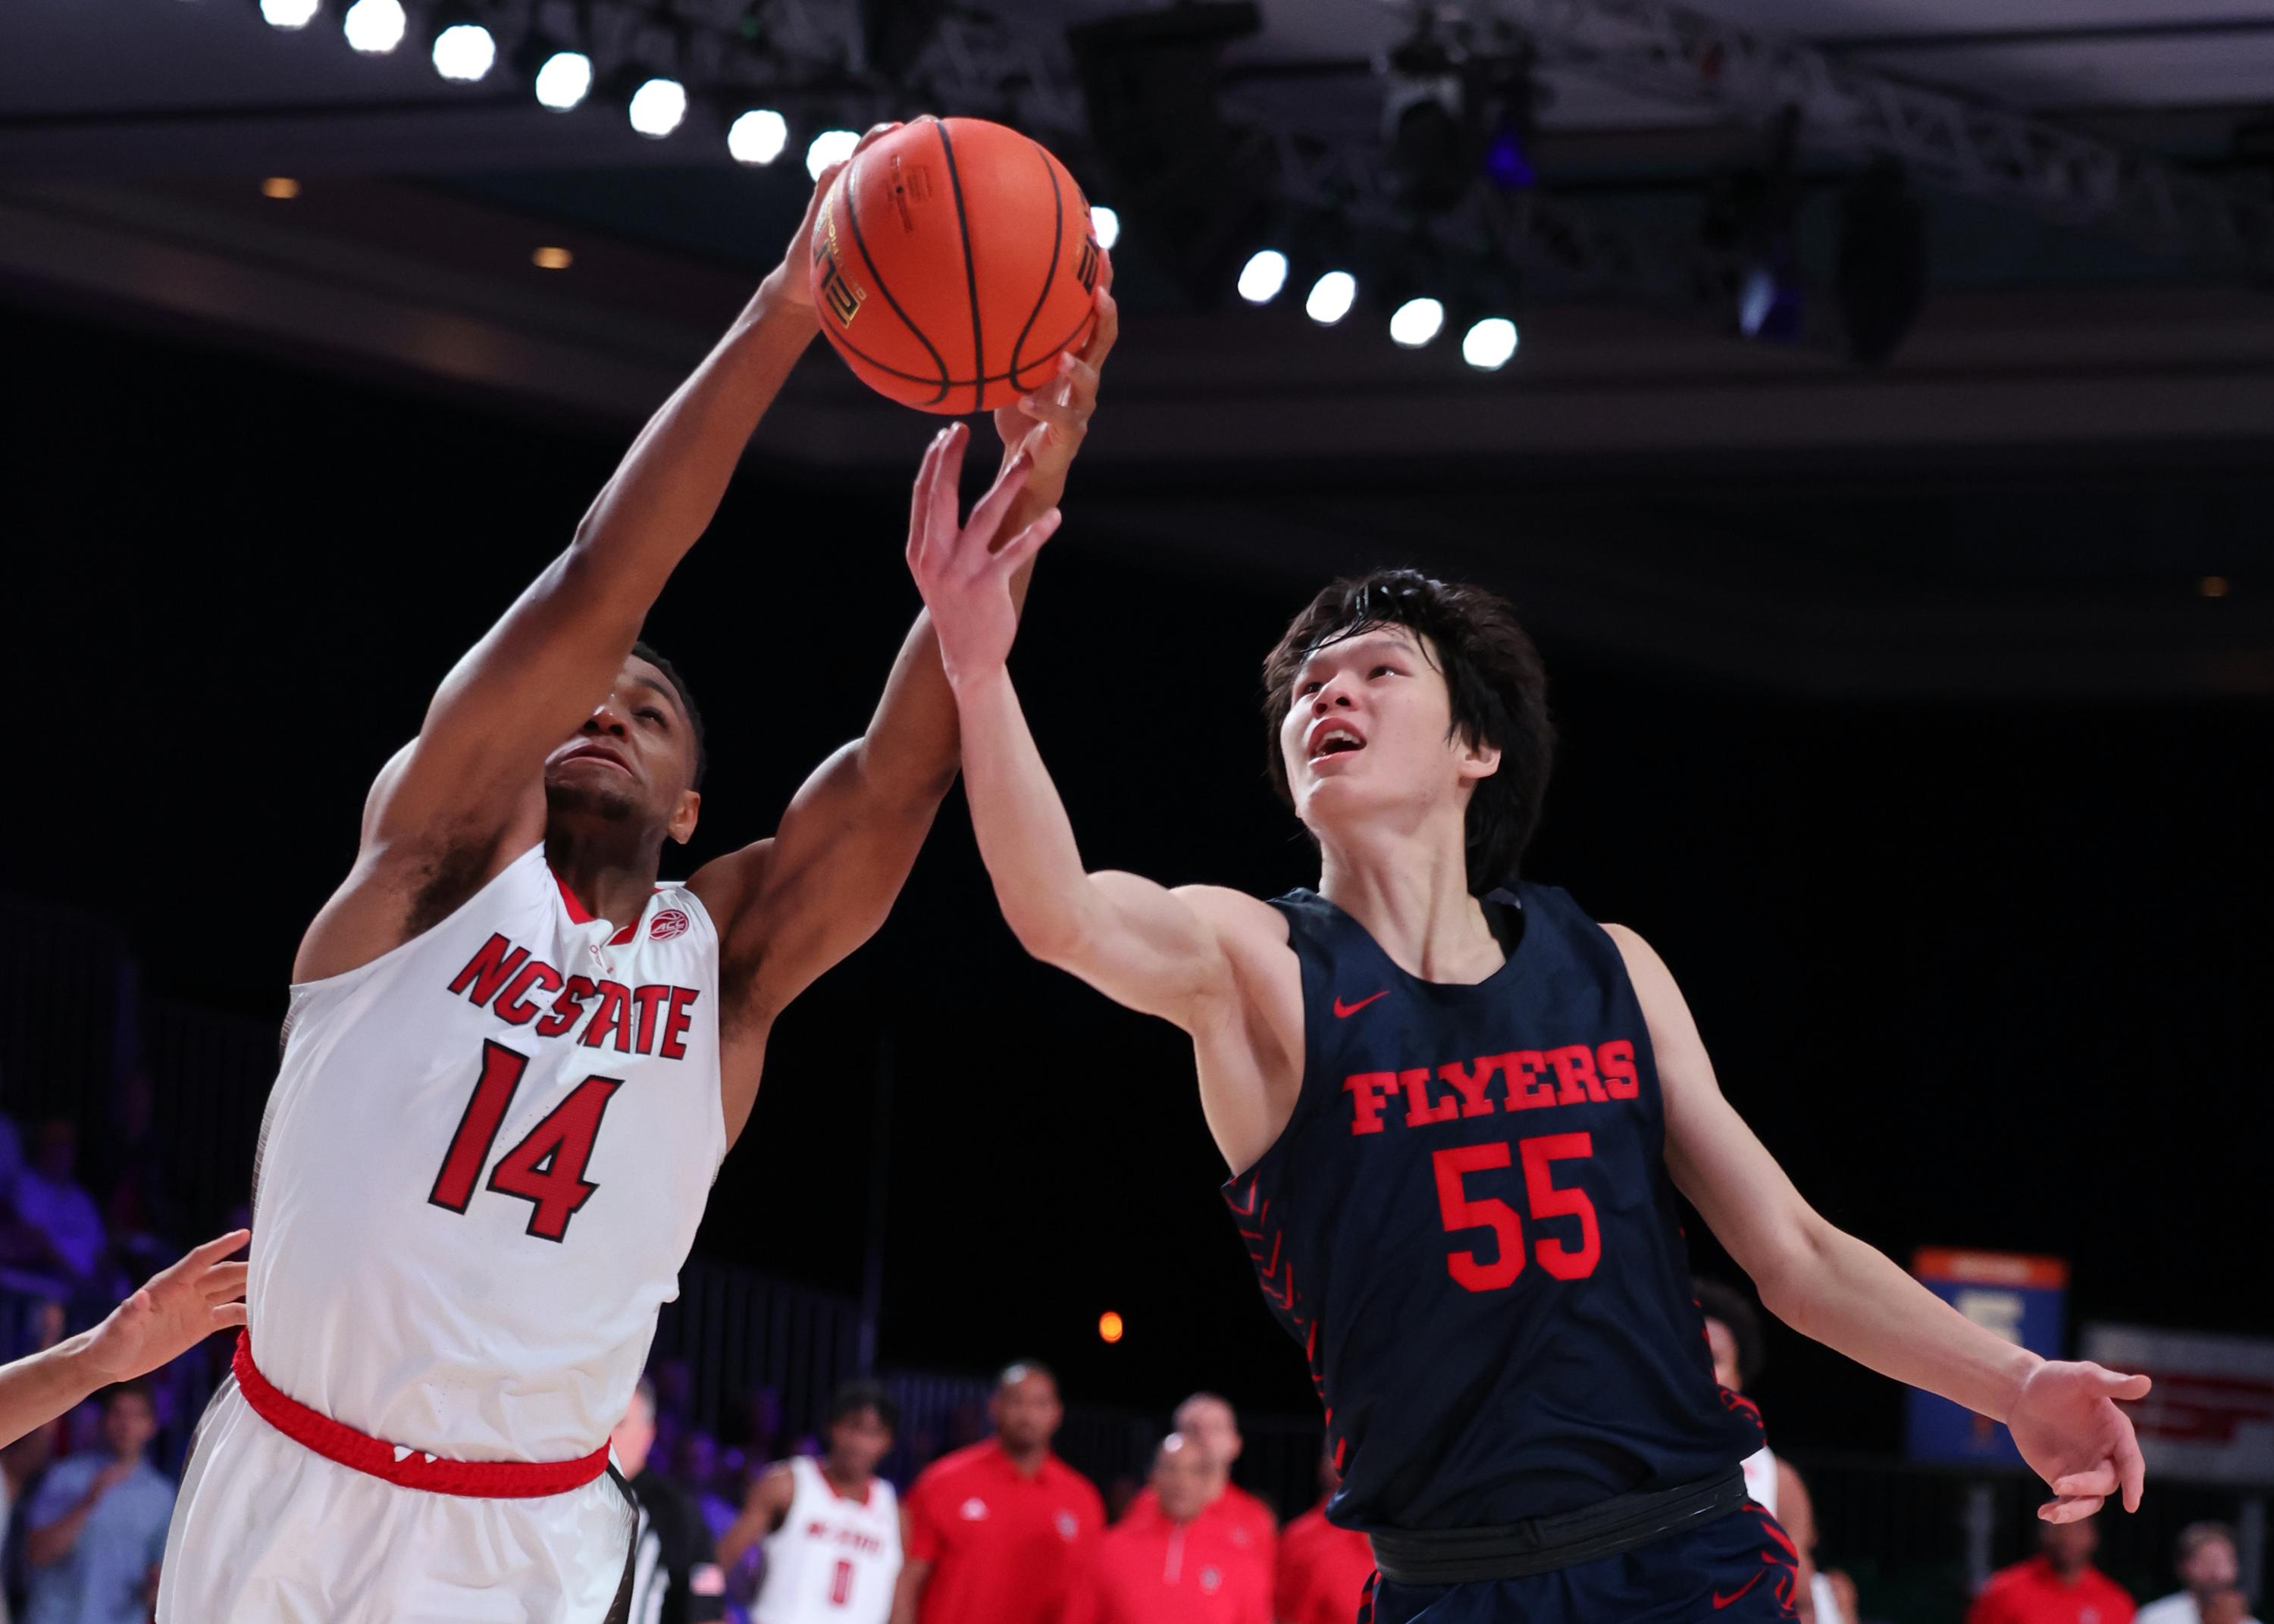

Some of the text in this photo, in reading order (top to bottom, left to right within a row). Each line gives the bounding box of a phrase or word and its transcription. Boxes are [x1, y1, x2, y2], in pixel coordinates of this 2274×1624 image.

[653, 918, 685, 932] ACC
[428, 1037, 626, 1244] 14
[1342, 1040, 1640, 1135] FLYERS
[1433, 1132, 1602, 1293] 55
